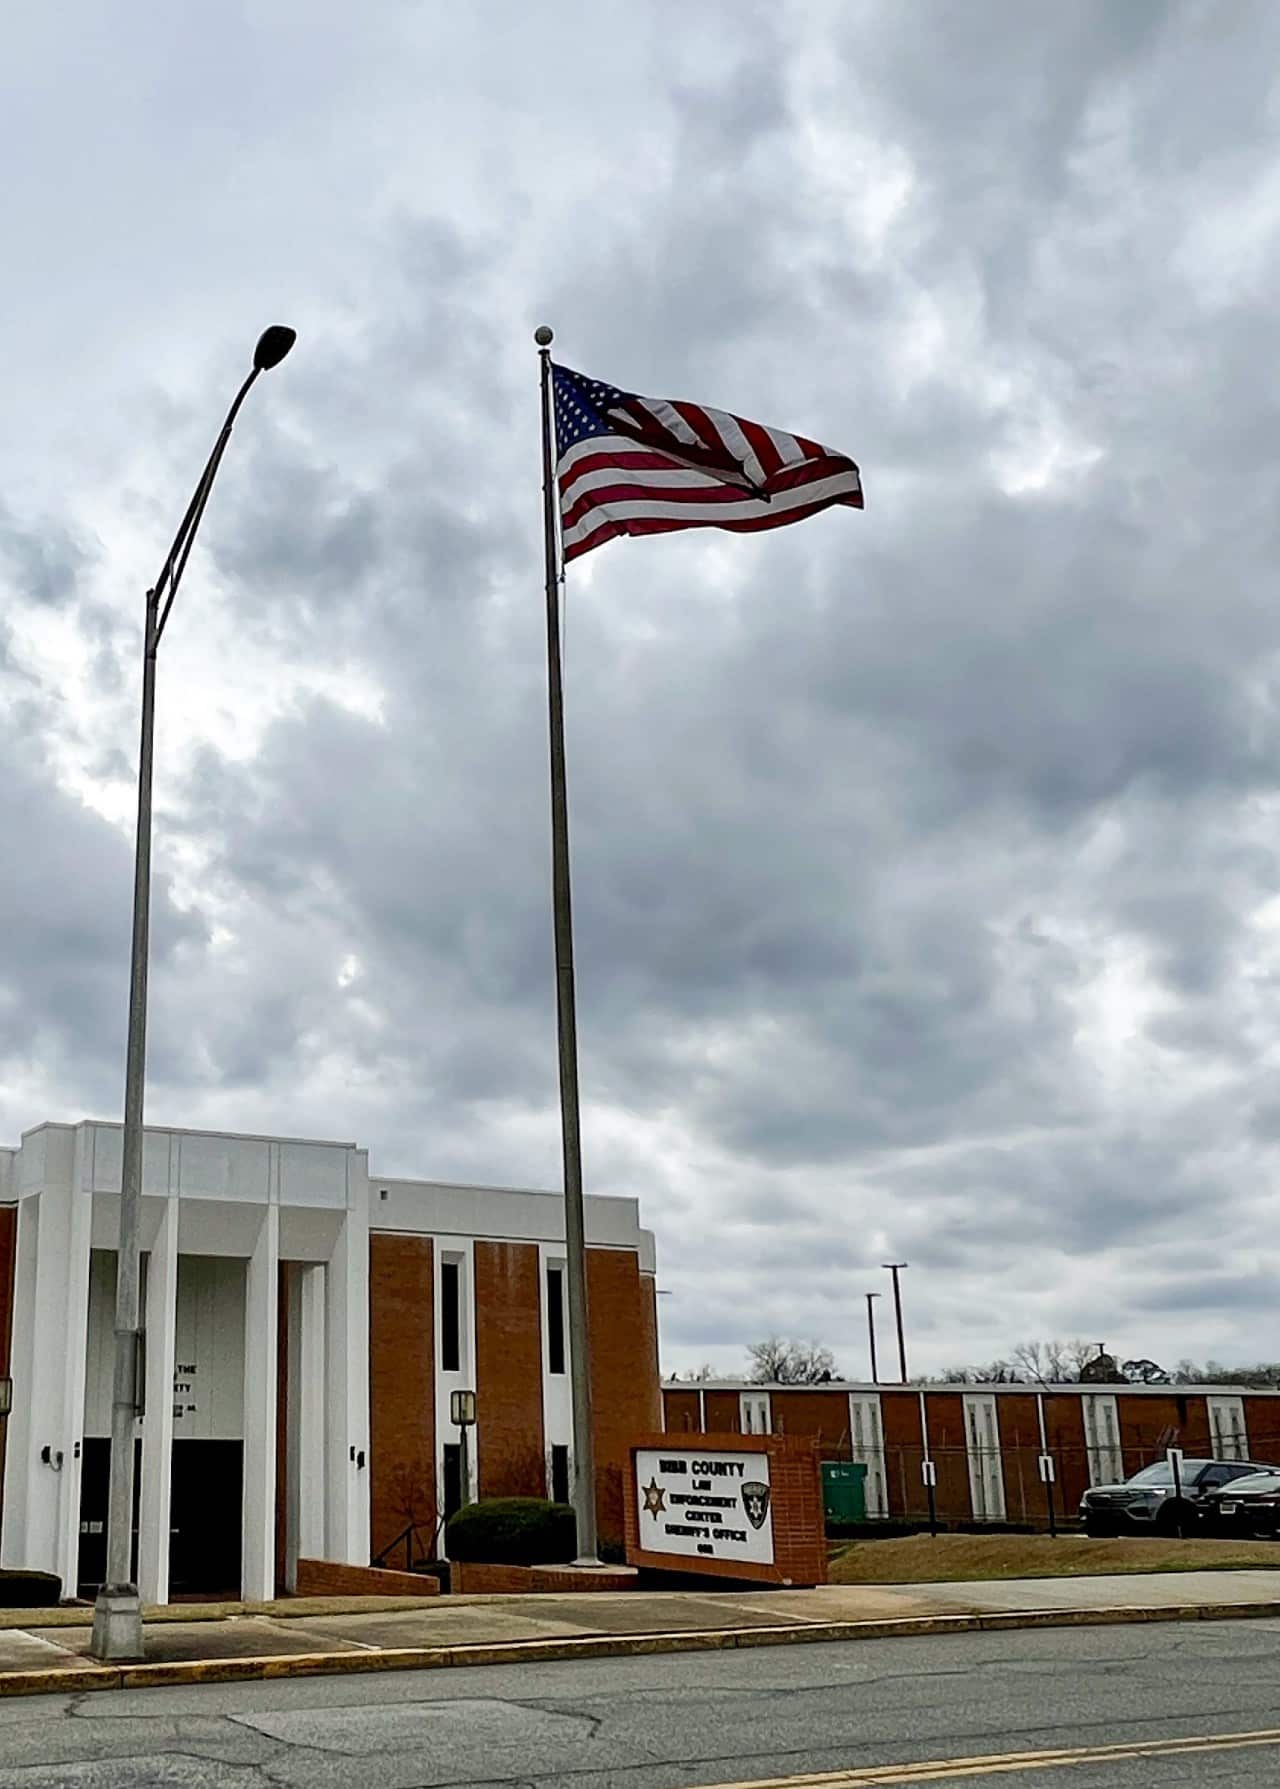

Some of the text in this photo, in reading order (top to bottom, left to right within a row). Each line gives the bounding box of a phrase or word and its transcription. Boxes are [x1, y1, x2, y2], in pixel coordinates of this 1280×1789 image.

[692, 1461, 744, 1477] COUNTY
[670, 1494, 737, 1508] ENFORCEMENT
[685, 1510, 722, 1523] CENTER
[712, 1528, 747, 1542] OFFICE
